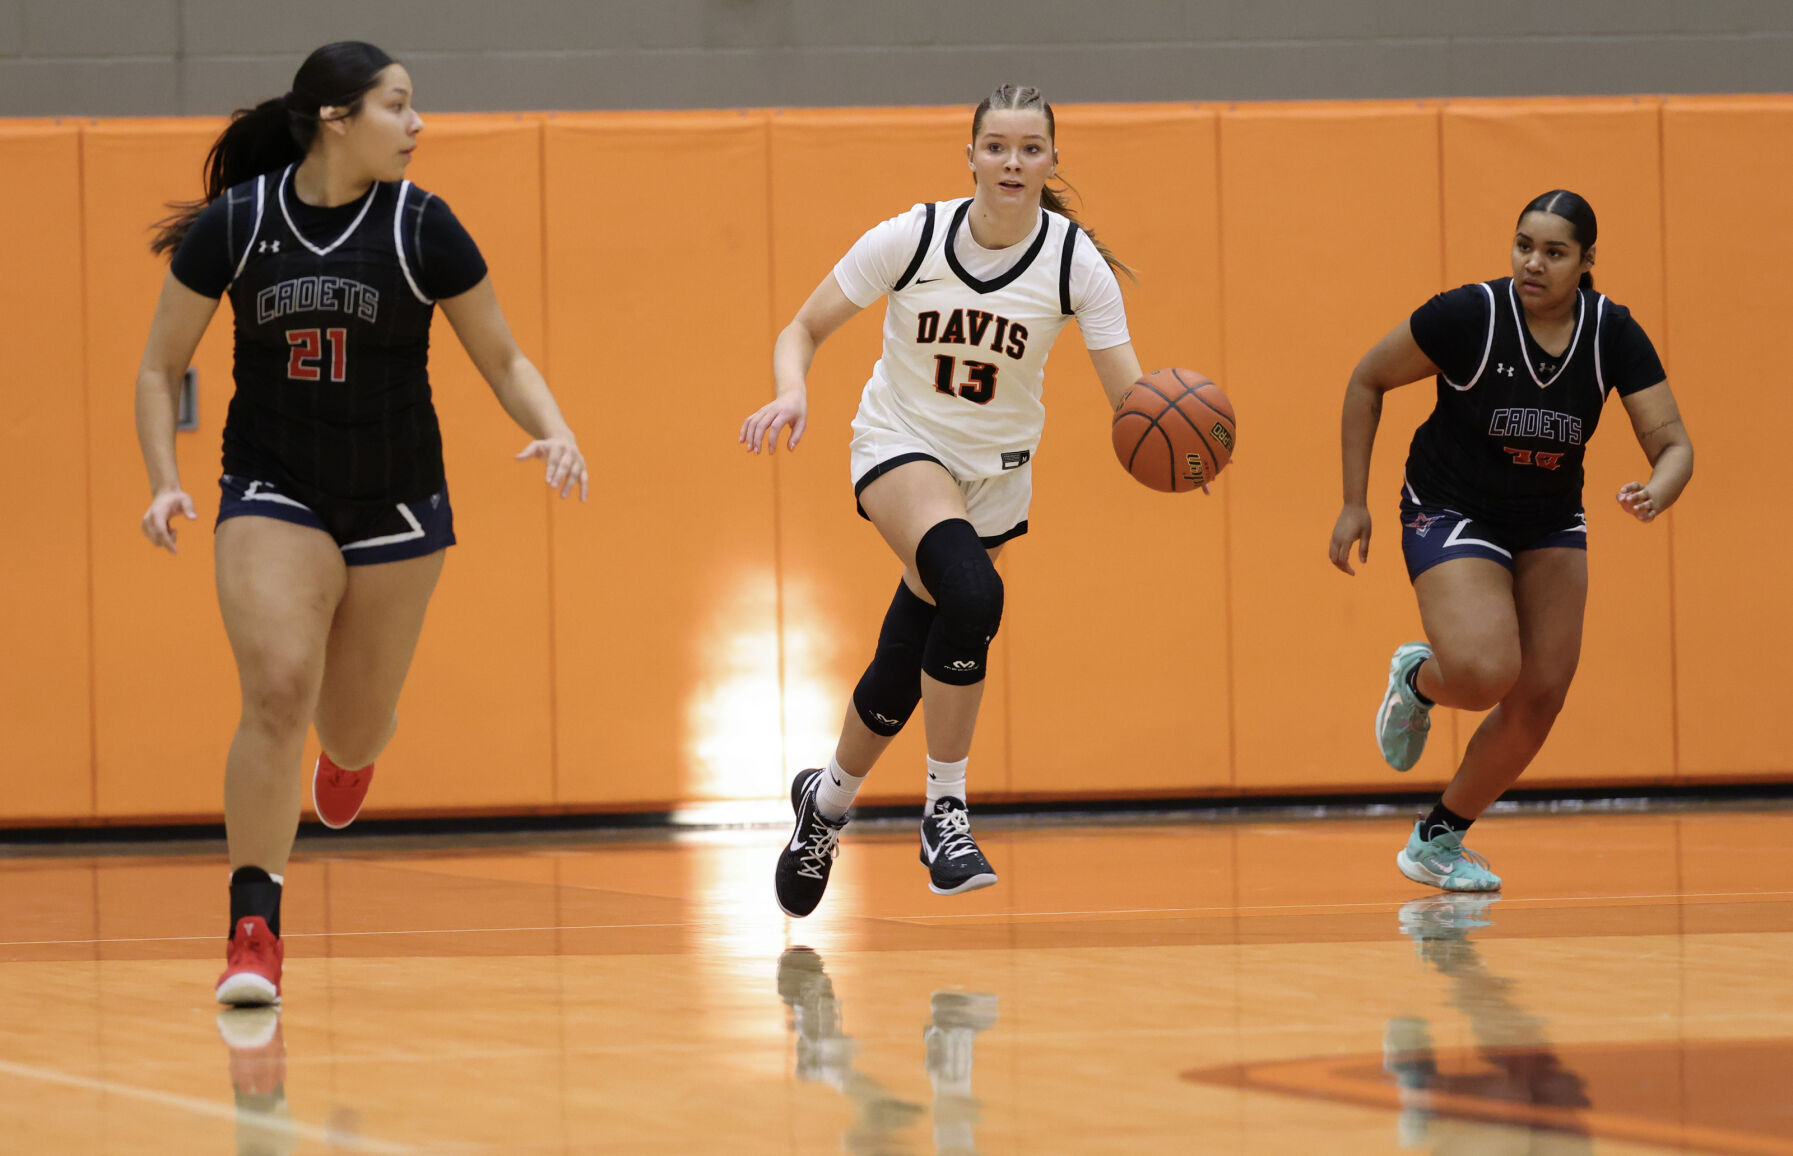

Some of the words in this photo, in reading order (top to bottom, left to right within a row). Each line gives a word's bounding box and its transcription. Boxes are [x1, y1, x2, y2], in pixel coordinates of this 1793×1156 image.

[257, 276, 379, 325] CADETS
[285, 328, 347, 382] 21
[916, 308, 1029, 360] DAVIS
[933, 353, 999, 405] 13
[1488, 407, 1582, 445] CADETS
